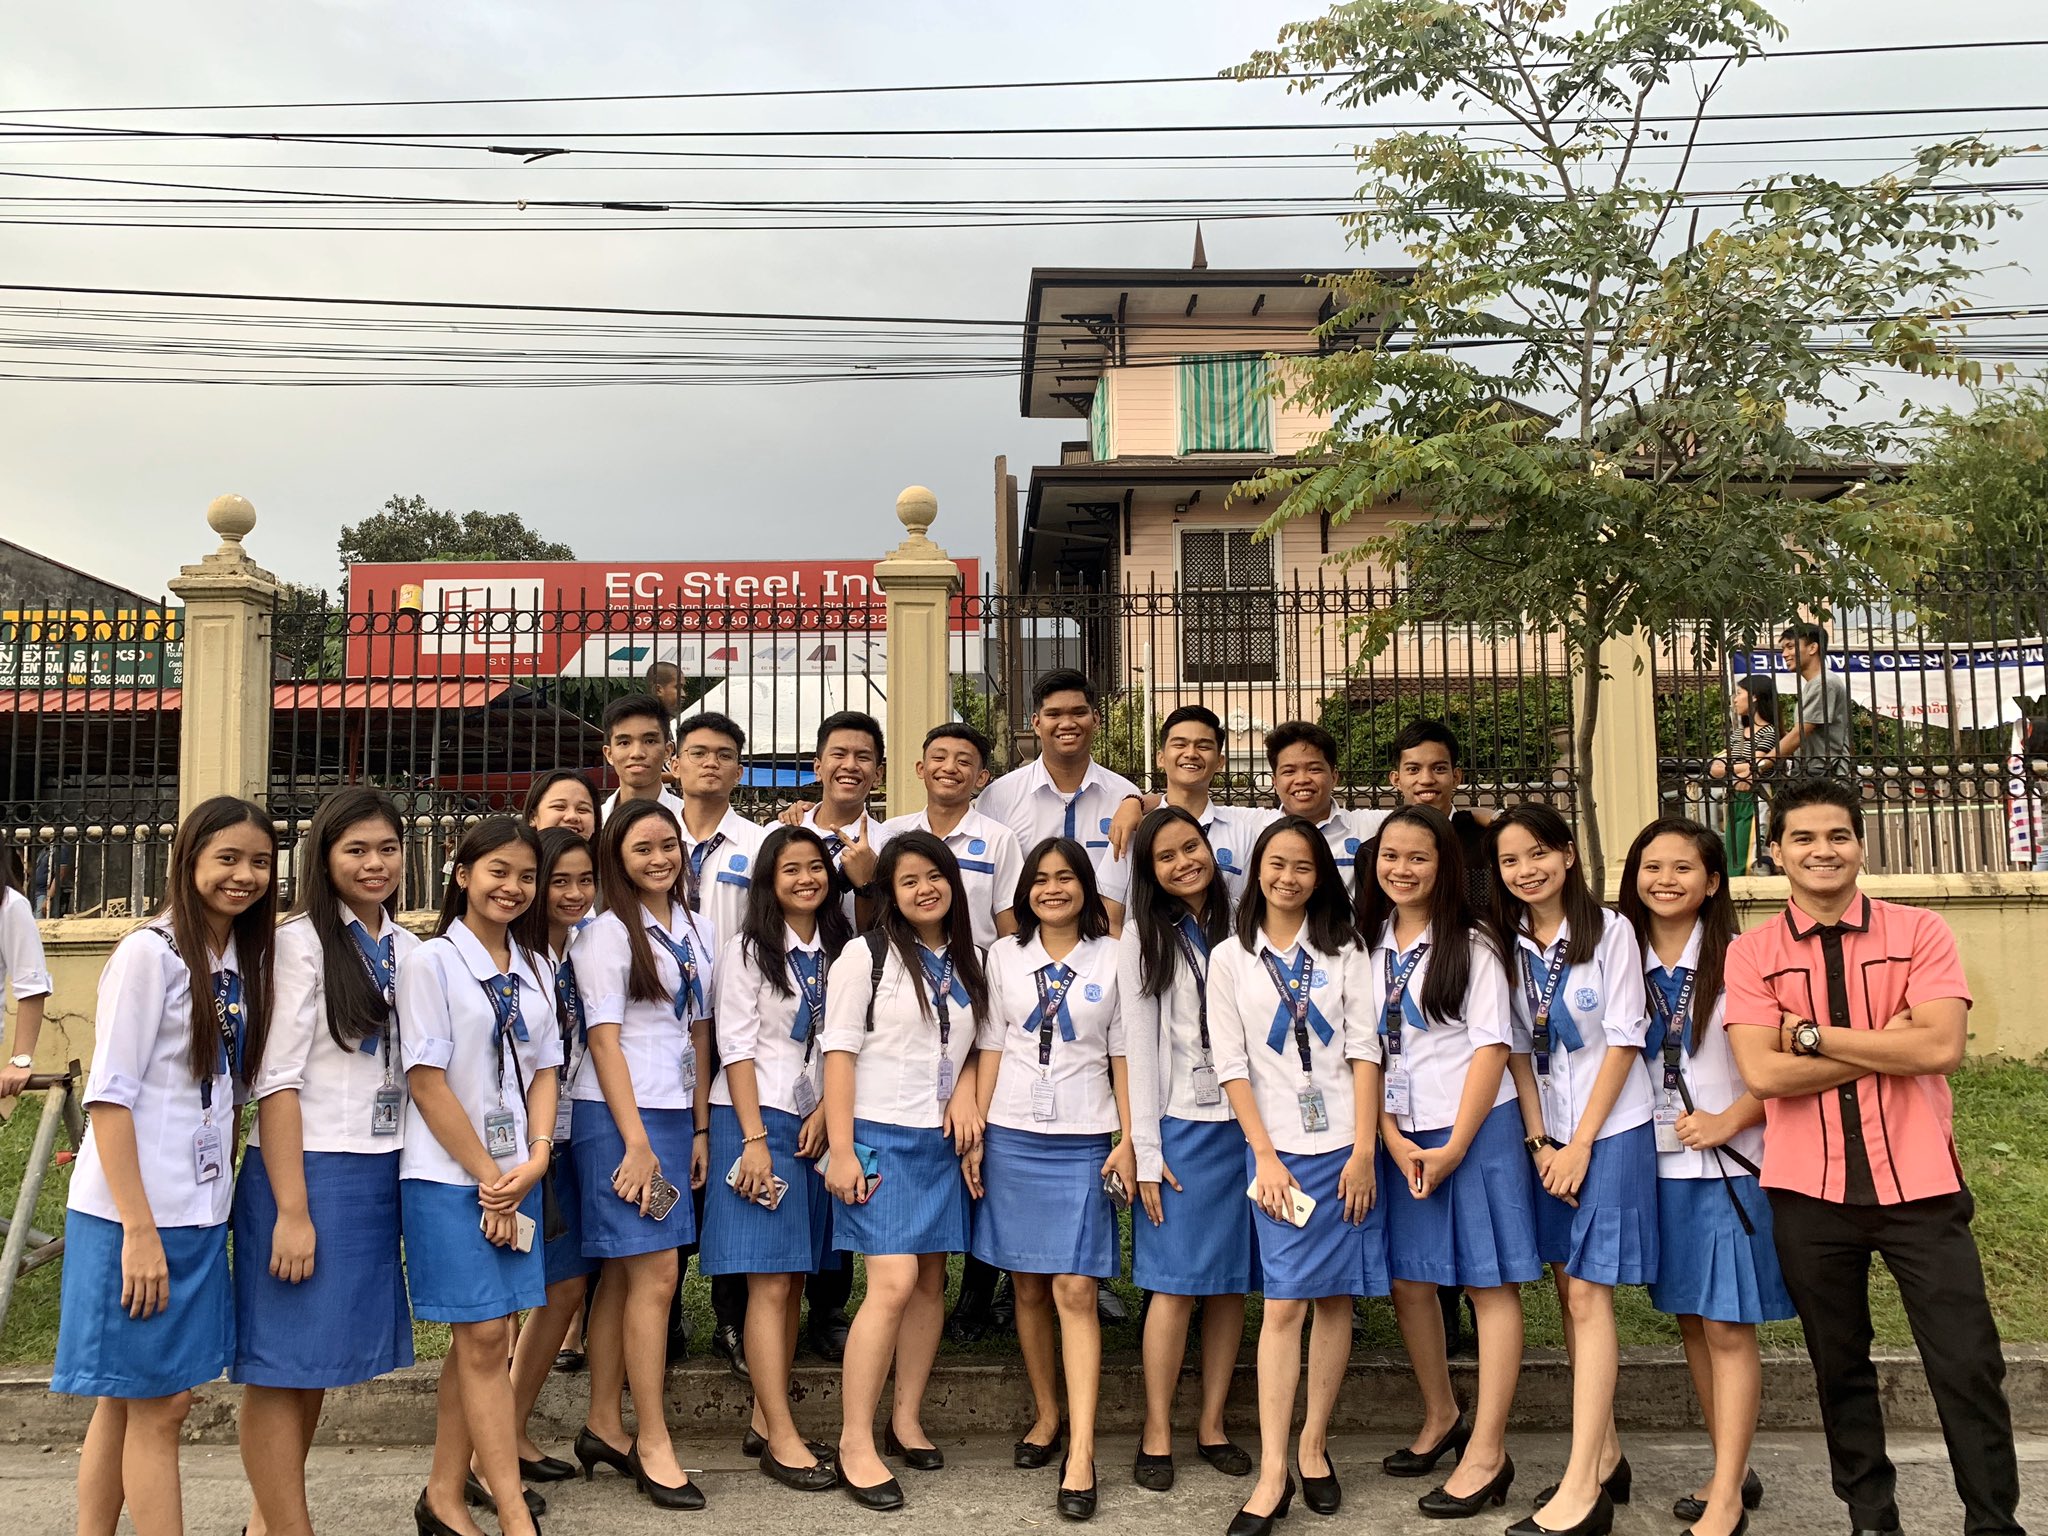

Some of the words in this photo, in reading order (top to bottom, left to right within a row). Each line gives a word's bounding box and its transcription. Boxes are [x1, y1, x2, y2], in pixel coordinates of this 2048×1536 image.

[606, 571, 664, 598] EC
[683, 571, 806, 598] Steel
[609, 602, 654, 612] Rooing
[668, 602, 724, 611] Sanrel
[740, 602, 771, 610] Seel
[22, 650, 60, 662] EXIT
[114, 649, 145, 663] CSO
[488, 655, 542, 666] steel
[1978, 647, 2045, 664] Mayor
[943, 960, 952, 981] LICEO
[1303, 958, 1312, 970] DE
[1397, 962, 1415, 988] LICEO
[1413, 948, 1424, 960] DE
[1053, 979, 1070, 1004] LICEO
[1300, 973, 1310, 1002] LICEO
[1542, 974, 1557, 1005] LICEO
[1553, 956, 1563, 971] DE
[510, 989, 519, 1018] LICEO
[568, 987, 576, 1013] LICEO
[1676, 985, 1691, 1015] LICEO
